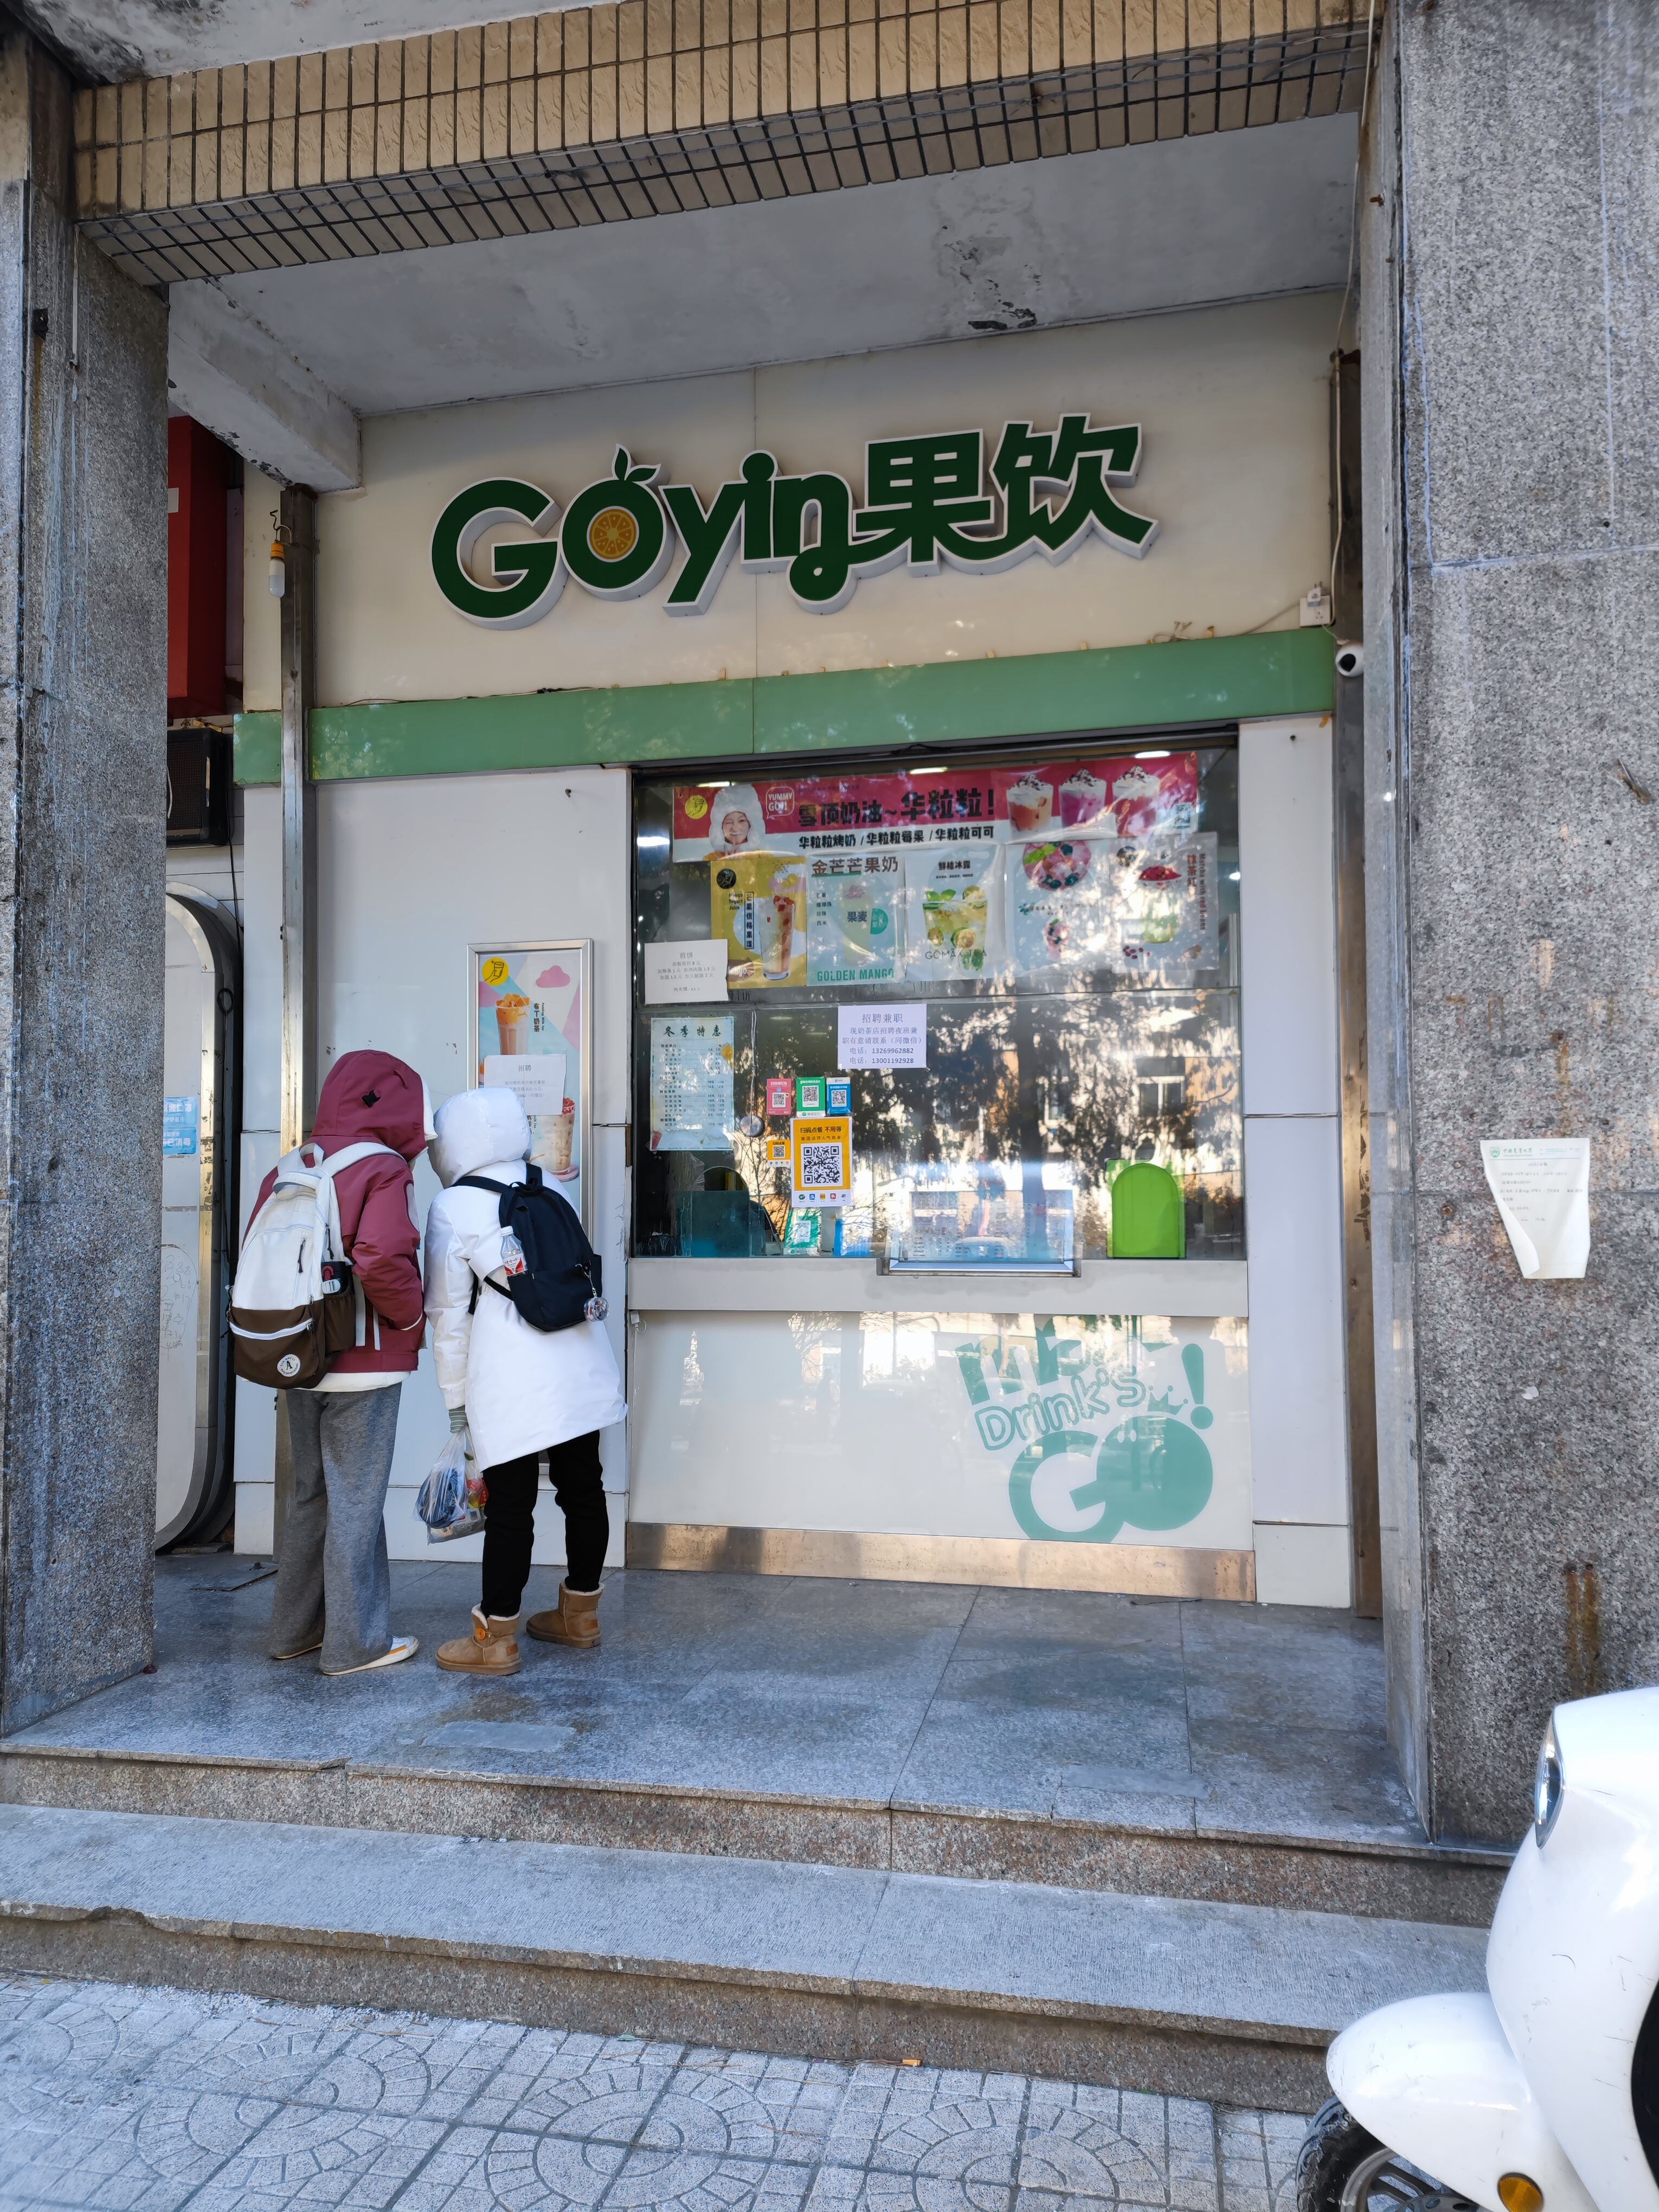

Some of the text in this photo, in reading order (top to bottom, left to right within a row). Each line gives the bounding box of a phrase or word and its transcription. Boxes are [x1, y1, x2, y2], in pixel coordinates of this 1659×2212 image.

[768, 793, 793, 801] YUMMY
[799, 834, 856, 849] 华粒粒烤奶
[935, 826, 994, 841] 华粒粒可可
[812, 856, 898, 877] 金芒芒果奶
[847, 911, 867, 922] 果麦
[817, 968, 895, 982] GOLDEN MANGO
[861, 1013, 903, 1024] 招聘兼职
[663, 1025, 722, 1038] 冬季特惠
[850, 1027, 918, 1035] 现奶茶店招聘夜班兼
[286, 1360, 293, 1371] A
[974, 1364, 1147, 1451] Drink's
